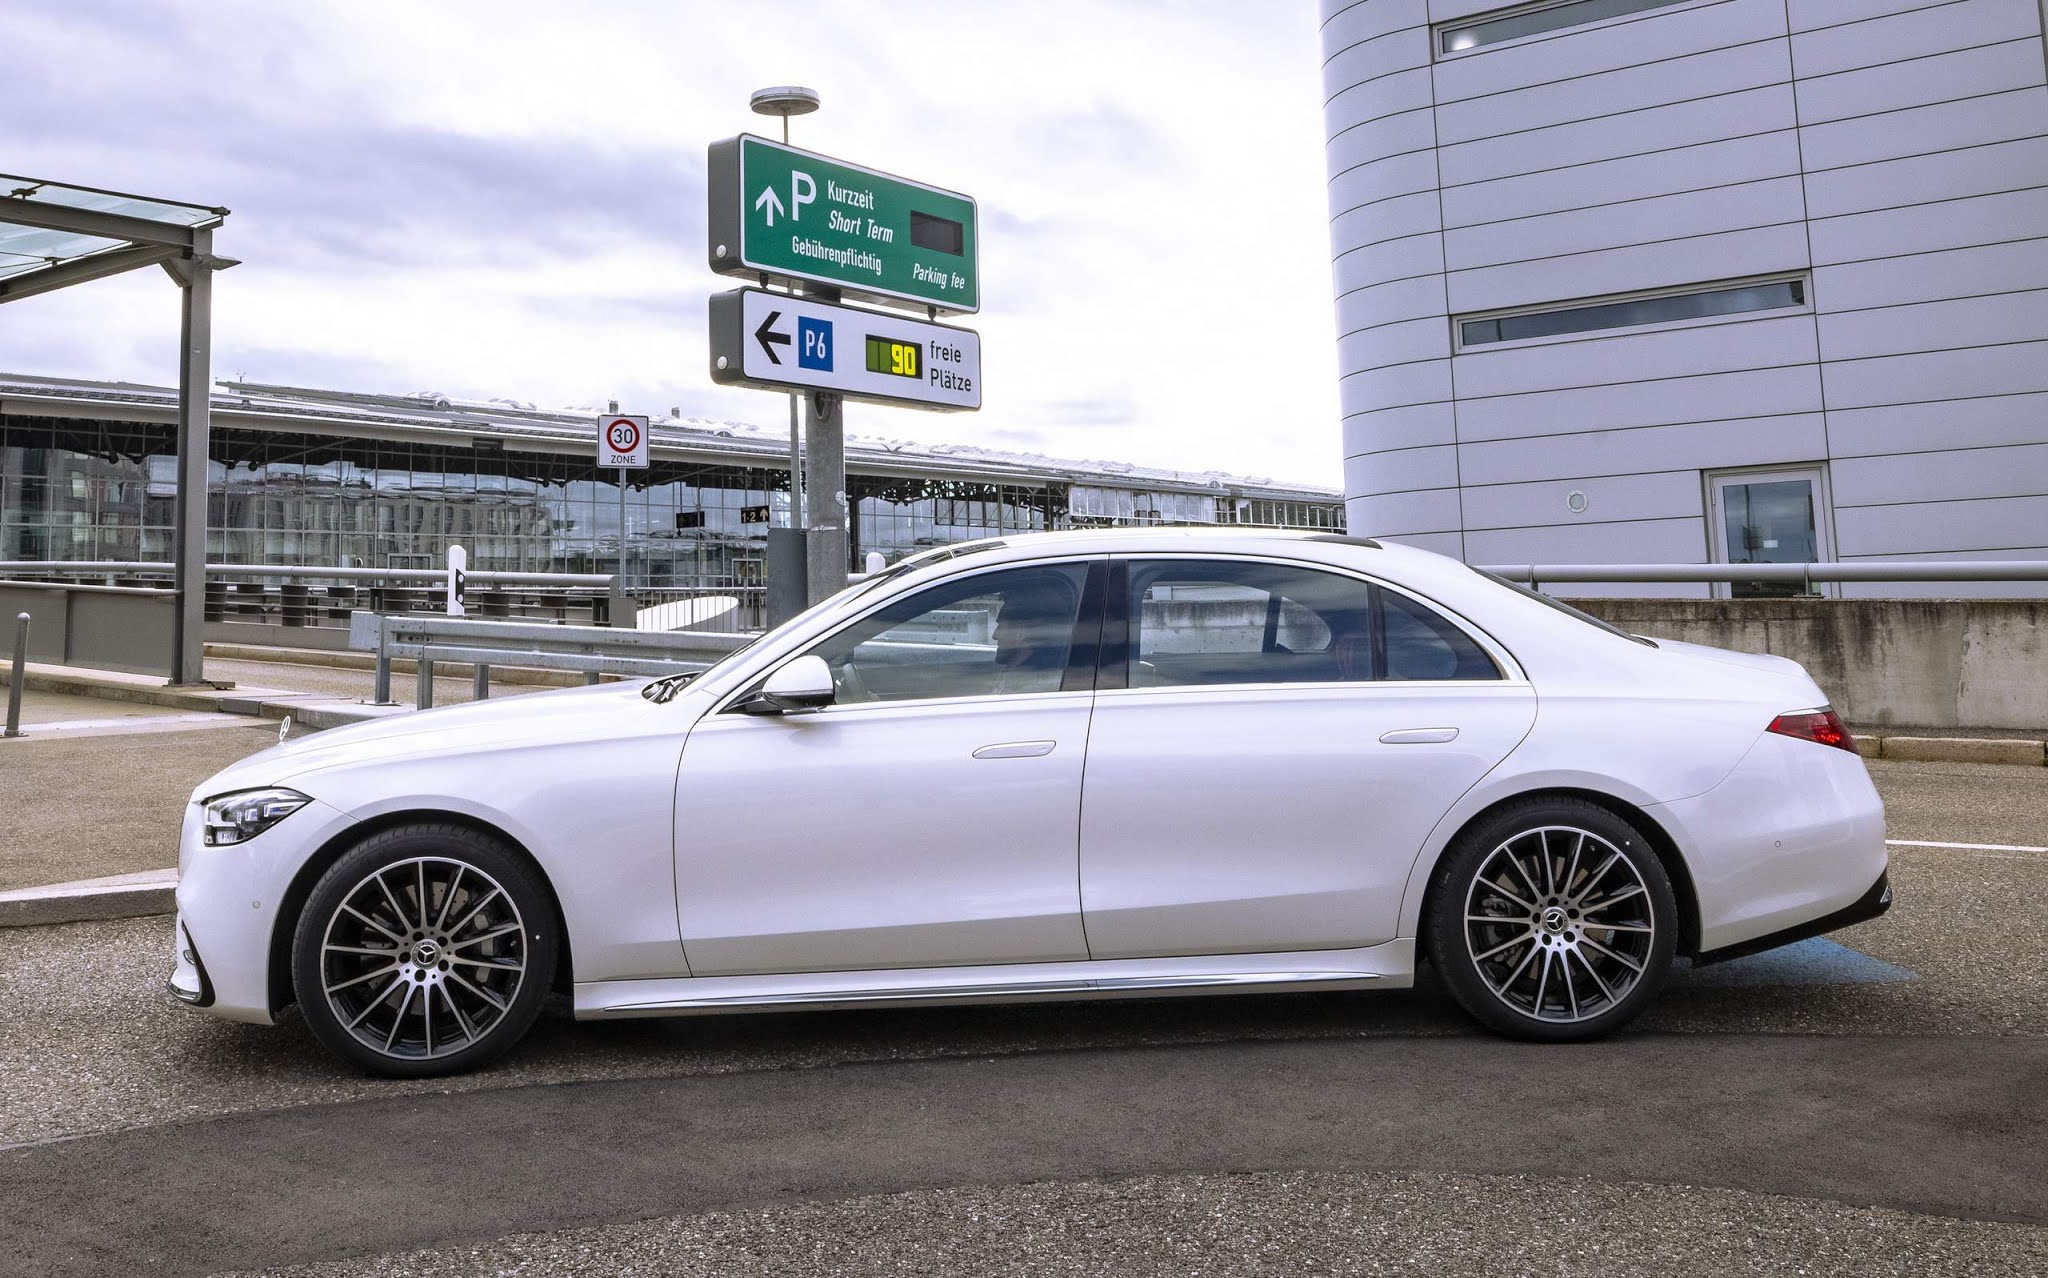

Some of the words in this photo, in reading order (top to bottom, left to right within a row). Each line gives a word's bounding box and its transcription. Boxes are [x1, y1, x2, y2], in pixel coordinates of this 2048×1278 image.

[792, 170, 817, 221] P
[827, 180, 874, 210] Kurzzeit
[829, 210, 861, 235] Short
[867, 219, 893, 243] Term
[792, 235, 882, 276] Gebührenpflichtig
[913, 263, 947, 290] Parking
[951, 274, 965, 289] fee
[805, 329, 826, 359] P6
[930, 340, 961, 363] freie
[891, 344, 916, 377] 90
[930, 368, 972, 392] Plätze
[613, 428, 633, 444] 30
[610, 455, 636, 464] ZONE
